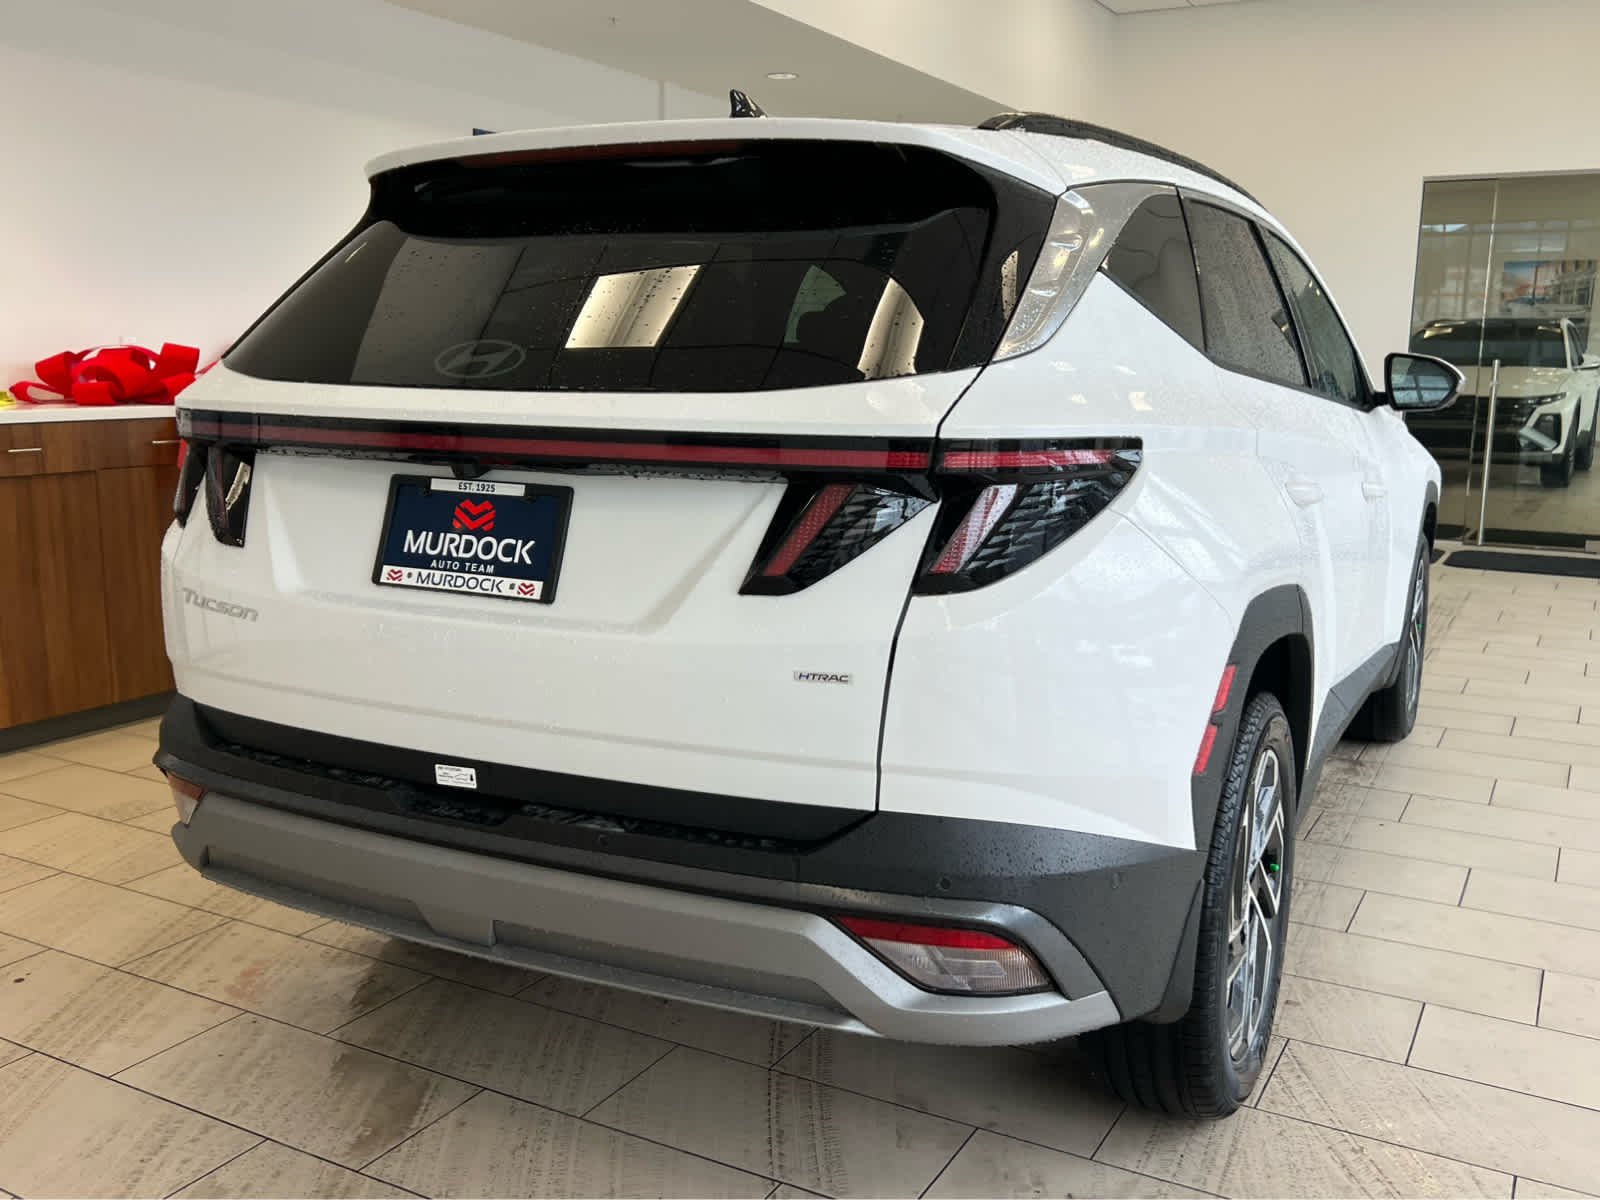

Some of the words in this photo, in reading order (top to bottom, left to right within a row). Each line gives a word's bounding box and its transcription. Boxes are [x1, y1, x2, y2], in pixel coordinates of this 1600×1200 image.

[458, 482, 475, 491] EST.
[476, 483, 495, 492] 1925
[404, 530, 535, 564] MURDOCK
[430, 560, 460, 570] AUTO
[465, 563, 494, 573] TEAM
[416, 571, 504, 592] MURDOCK
[798, 672, 849, 682] HTRAC
